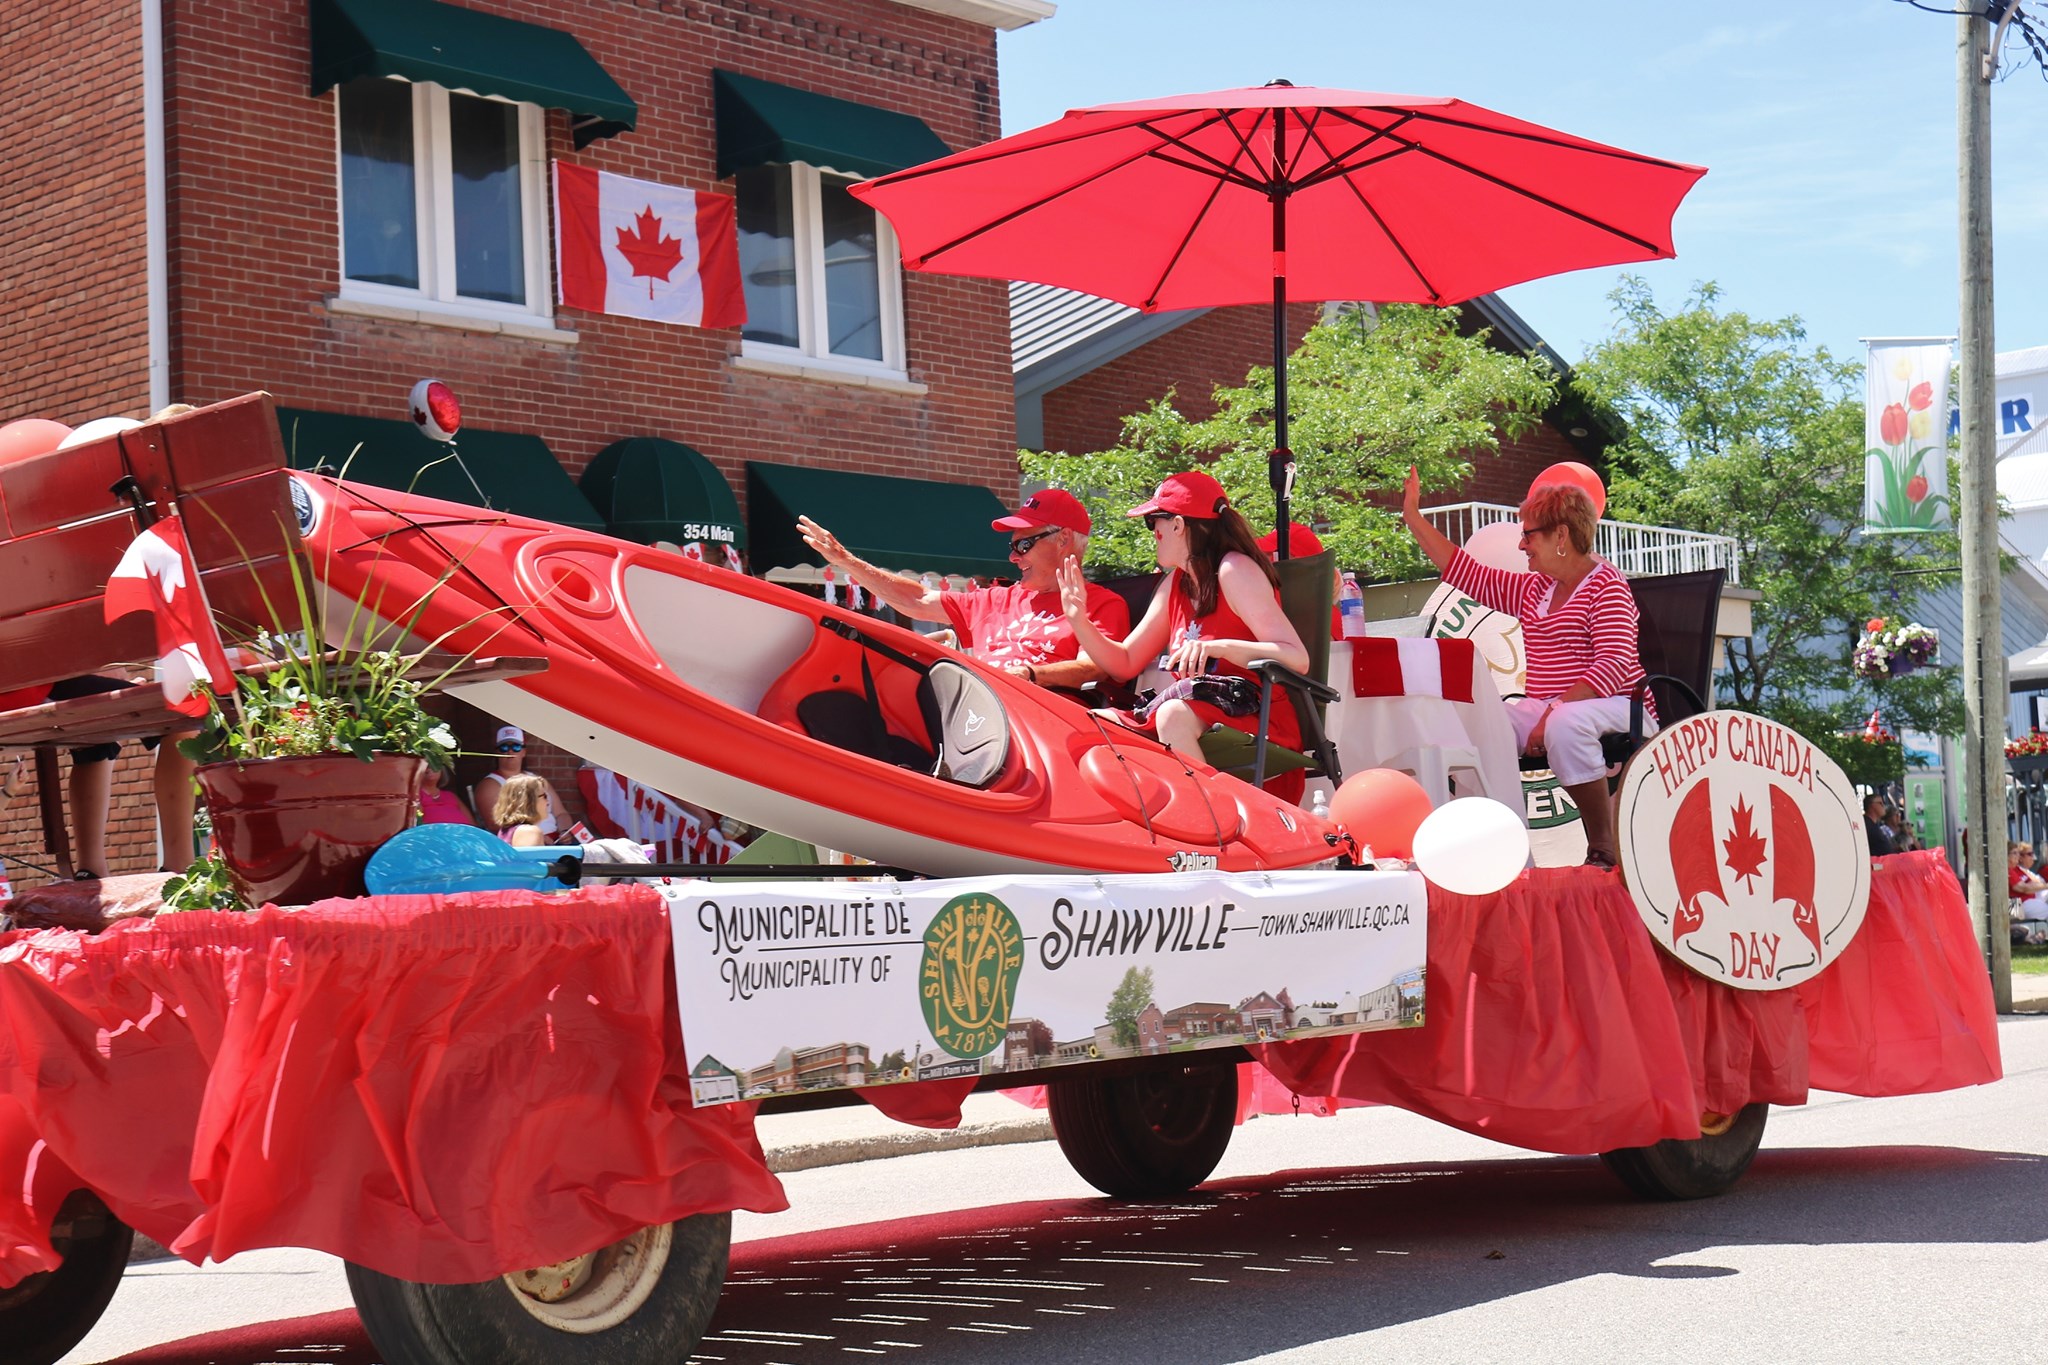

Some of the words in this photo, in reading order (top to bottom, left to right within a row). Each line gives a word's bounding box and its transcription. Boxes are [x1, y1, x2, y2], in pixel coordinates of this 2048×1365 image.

[683, 523, 709, 540] 354
[710, 525, 735, 543] Main
[1652, 716, 1719, 798] HAPPY
[1727, 715, 1813, 794] CANADA
[1166, 849, 1218, 873] Pelican
[698, 896, 875, 955] MUNICIPALITÉ
[884, 901, 911, 935] DE
[1040, 897, 1235, 971] SHAWVILLE
[1258, 903, 1410, 938] TOWN.SHAWVILLE.QC.CA
[720, 957, 863, 1001] MUNICIPALITY
[871, 954, 892, 983] OF
[1729, 931, 1781, 980] DAY
[952, 1025, 997, 1053] 1873
